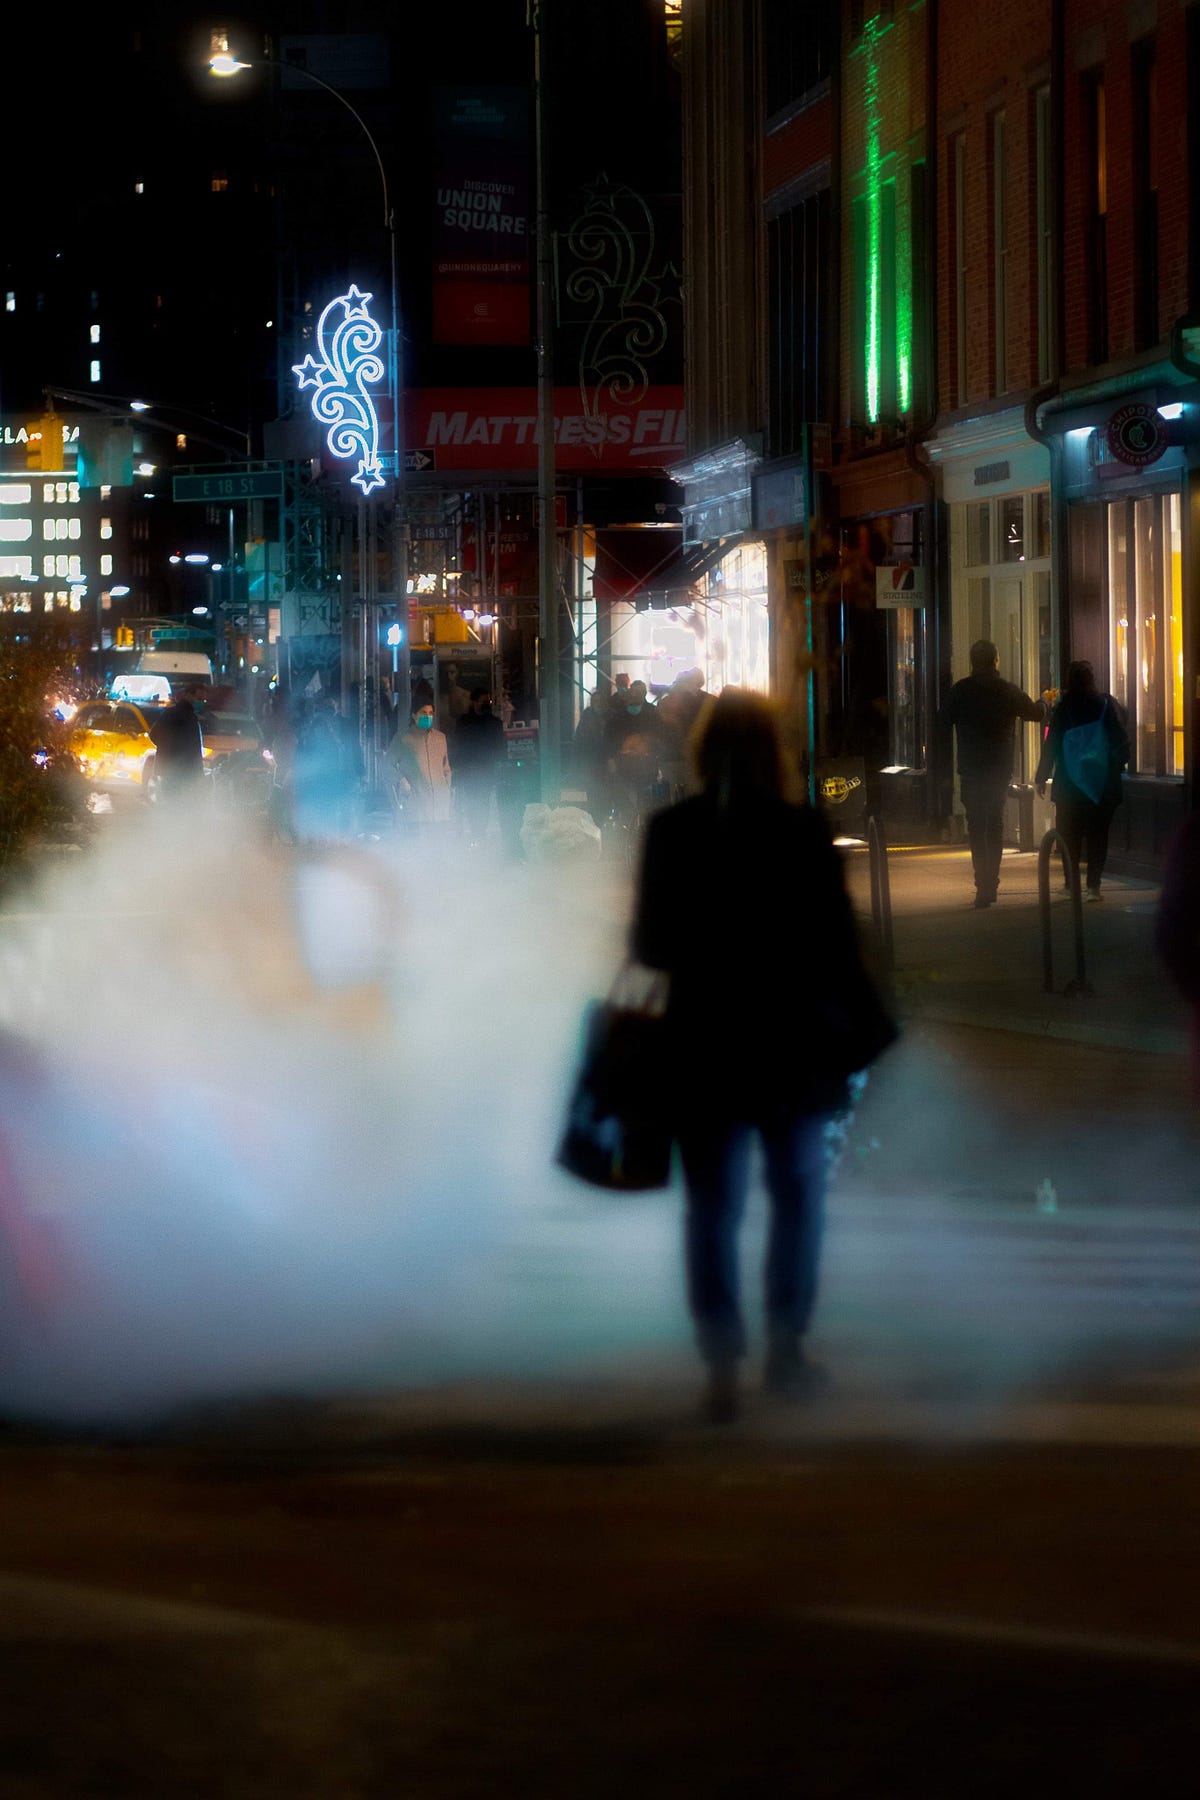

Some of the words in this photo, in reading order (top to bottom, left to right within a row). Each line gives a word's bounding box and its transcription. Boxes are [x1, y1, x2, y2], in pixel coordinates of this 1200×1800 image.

[464, 178, 515, 195] DISCOVER
[437, 187, 503, 212] UNION
[443, 207, 526, 235] SQUARE
[203, 480, 210, 495] E
[218, 479, 233, 494] 18
